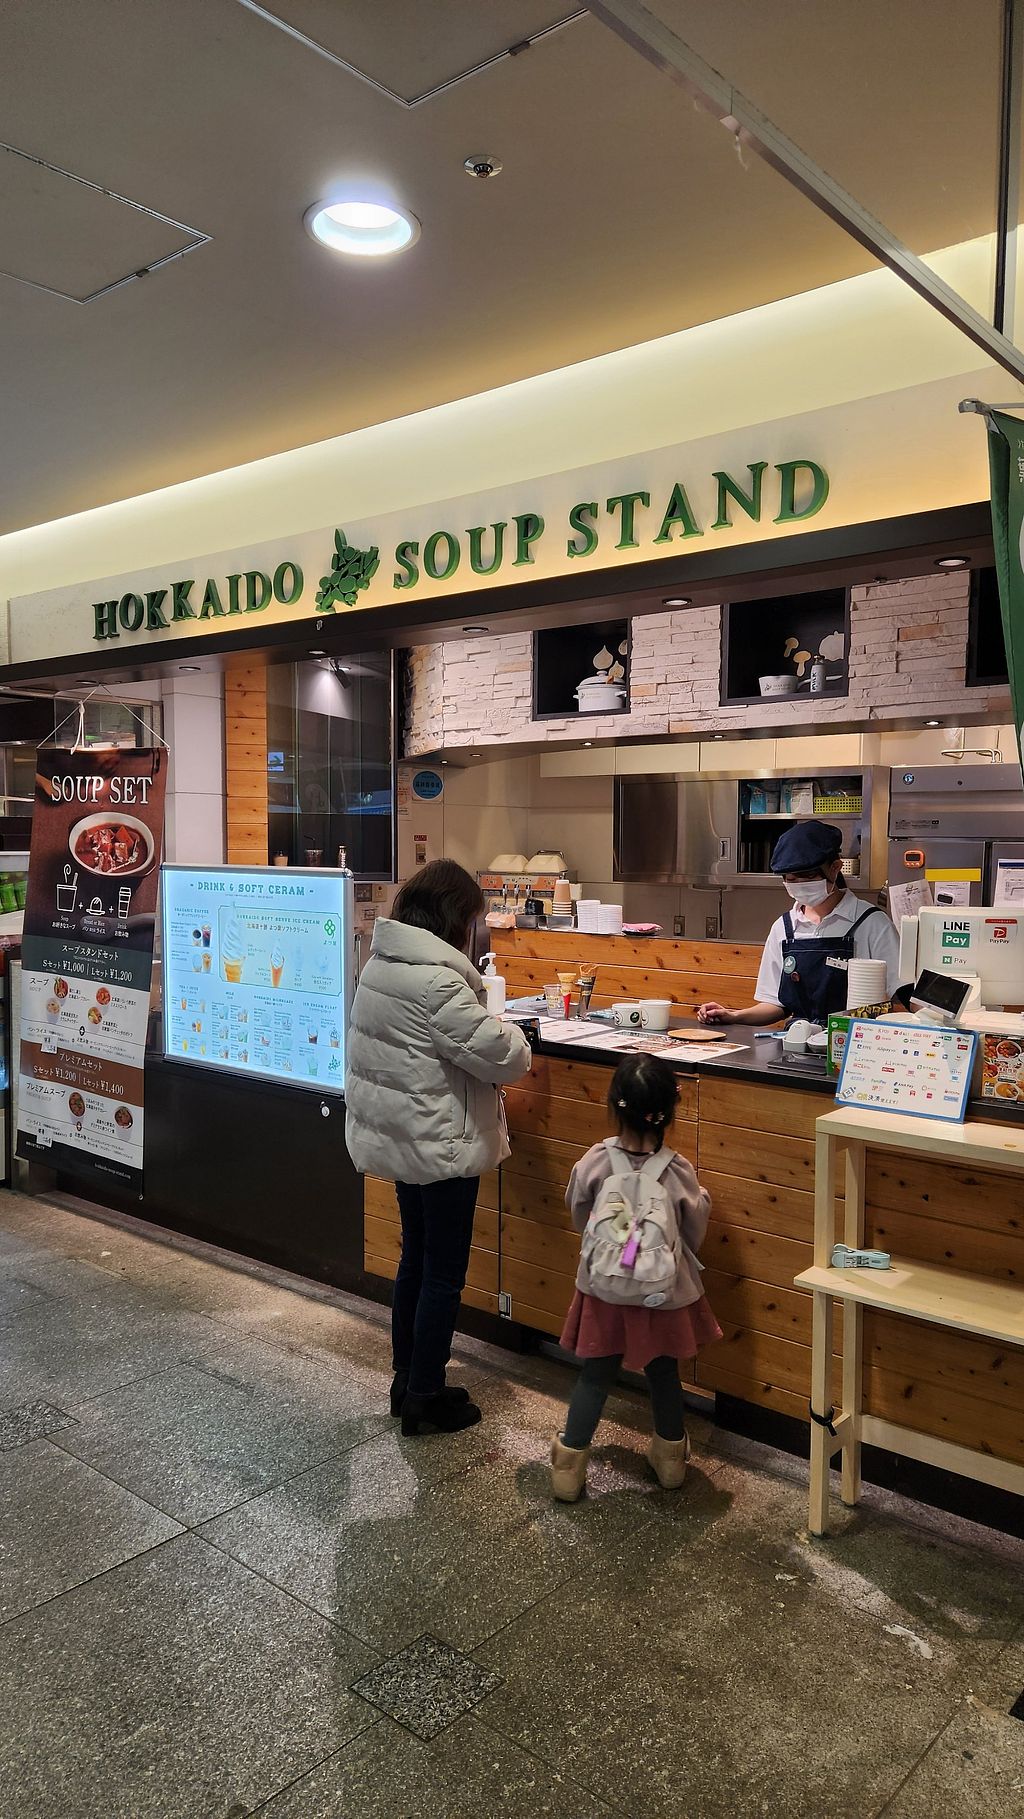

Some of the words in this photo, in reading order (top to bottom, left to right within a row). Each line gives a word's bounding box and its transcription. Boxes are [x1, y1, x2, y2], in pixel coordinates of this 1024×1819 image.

[92, 561, 304, 641] HOKKAIDO
[393, 513, 546, 590] SOUP
[567, 459, 830, 559] STAND
[51, 775, 105, 803] SOUP
[109, 776, 153, 804] SET
[197, 881, 225, 891] DRINK
[229, 883, 234, 892] &
[238, 883, 264, 894] SOFT
[268, 885, 305, 896] CERAM
[943, 921, 970, 931] LINE
[945, 935, 967, 946] Pay
[62, 944, 119, 961] スープスタンドセット
[42, 959, 61, 969] Sセット
[62, 960, 85, 974] ¥1,000
[110, 968, 132, 982] ¥1,200
[30, 977, 49, 985] スープ
[59, 1053, 103, 1072] プレミアムセット
[33, 1065, 53, 1076] Sセット
[55, 1067, 77, 1082] ¥1,200
[100, 1079, 124, 1095] ¥1,400
[26, 1082, 66, 1098] プレミアムスープ
